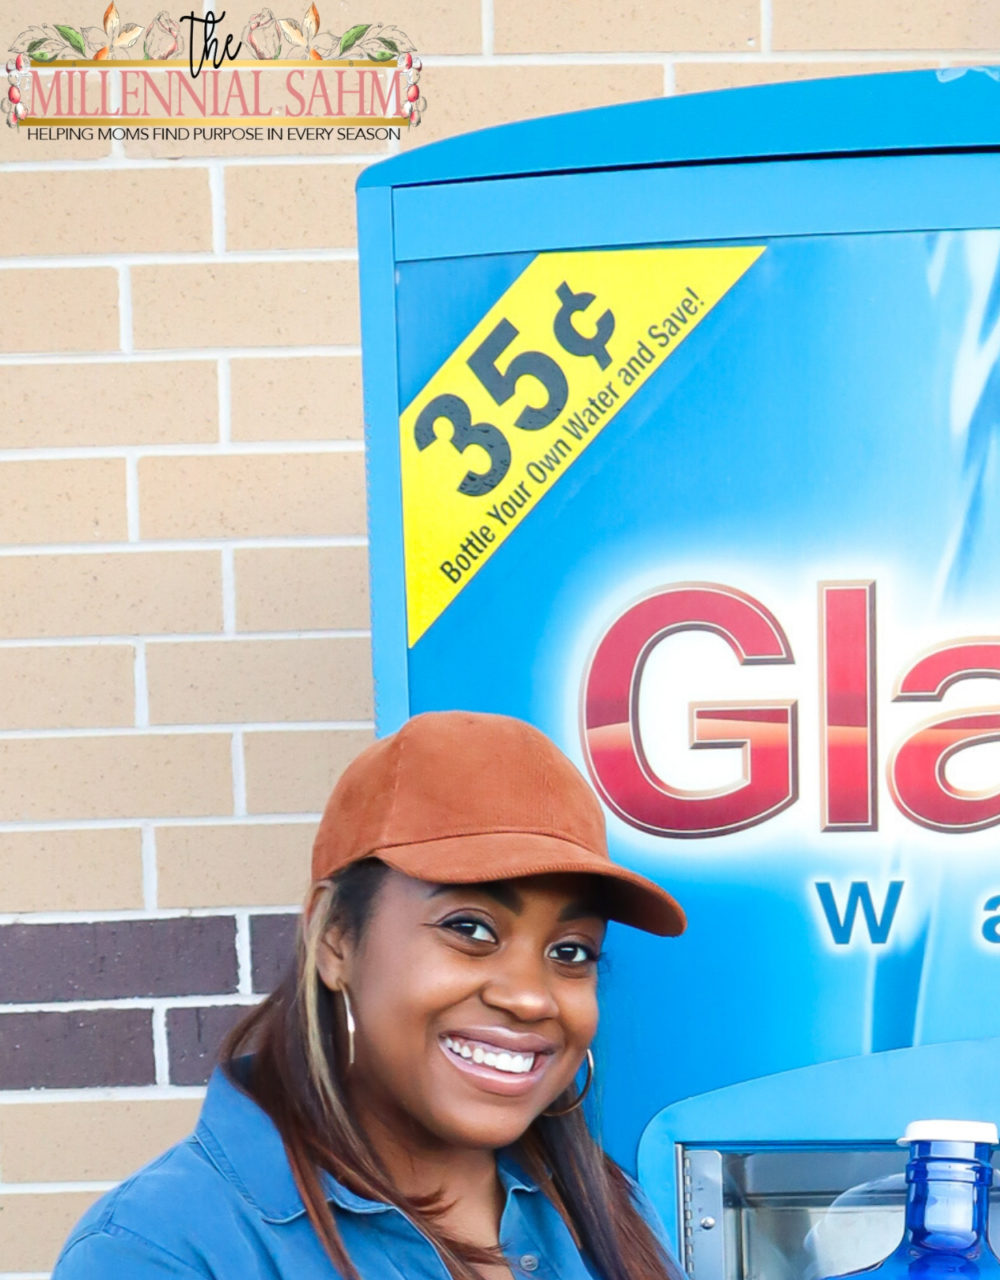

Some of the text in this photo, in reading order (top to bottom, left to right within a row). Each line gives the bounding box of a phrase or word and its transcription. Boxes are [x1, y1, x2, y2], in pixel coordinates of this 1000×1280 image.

[413, 280, 615, 497] 35¢
[440, 286, 705, 584] Bottle Your Own Water and Save!
